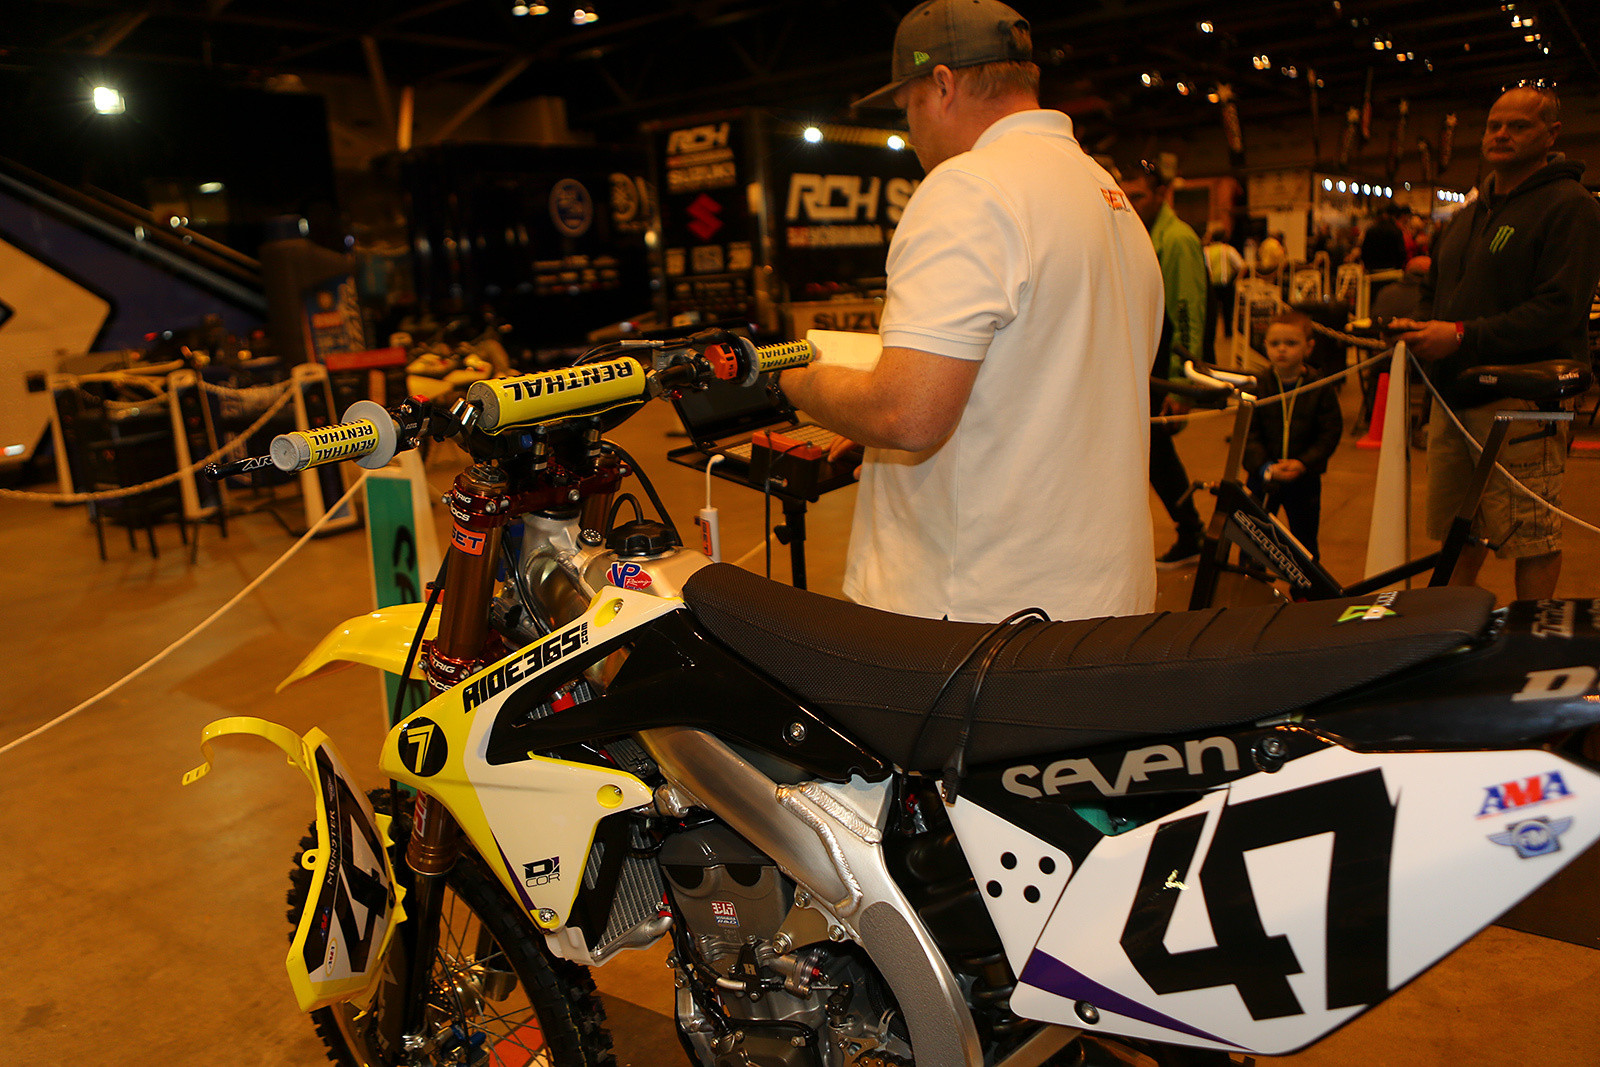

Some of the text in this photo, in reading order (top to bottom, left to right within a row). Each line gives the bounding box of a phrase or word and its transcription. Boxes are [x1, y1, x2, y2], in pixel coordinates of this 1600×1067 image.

[786, 173, 881, 221] RCH
[760, 345, 808, 359] RENTHAL
[761, 353, 810, 369] RENTHAL
[503, 360, 634, 402] RENTHAL
[310, 424, 374, 446] RENTHAL
[315, 438, 376, 461] RENTHAL
[611, 562, 641, 589] VP
[462, 625, 582, 714] RIDE365
[406, 723, 436, 774] 7
[1474, 770, 1571, 817] AMA
[1119, 766, 1401, 1022] 47
